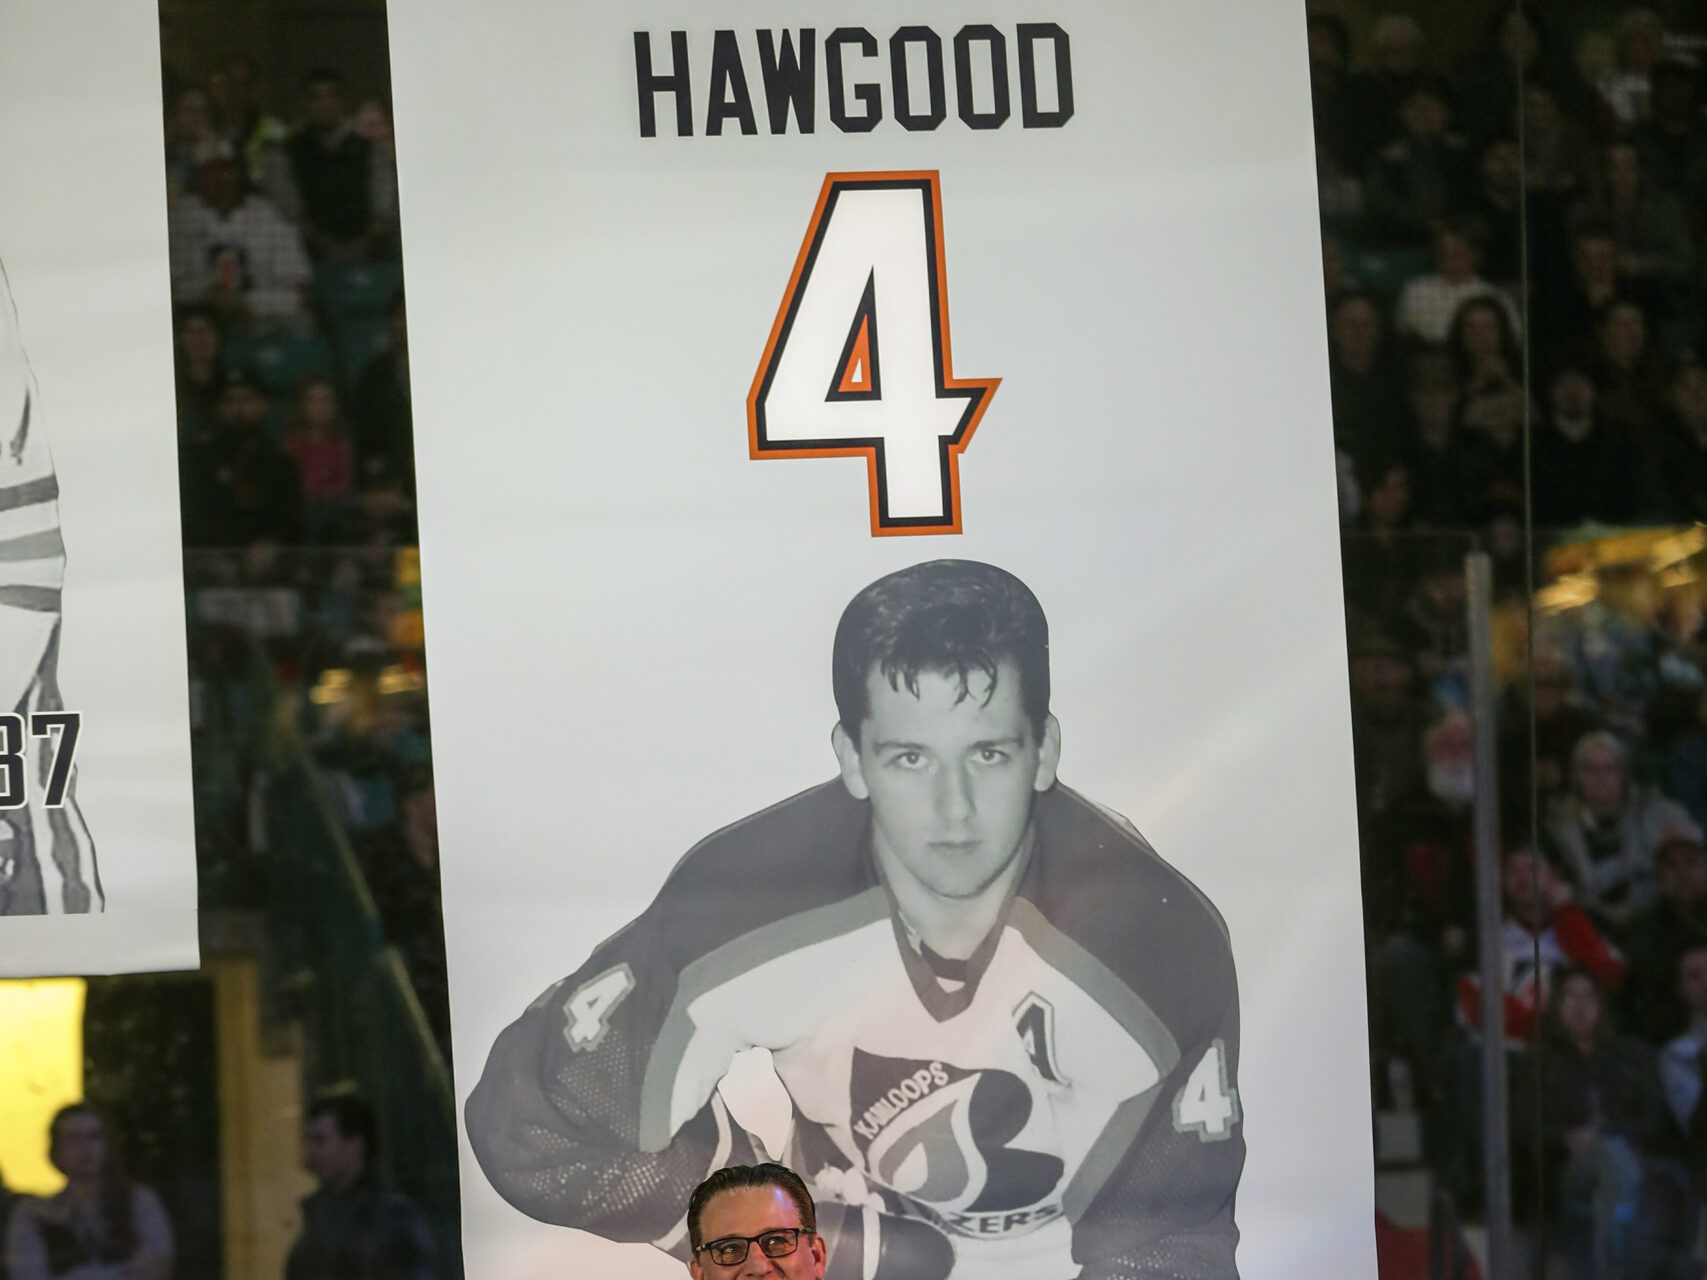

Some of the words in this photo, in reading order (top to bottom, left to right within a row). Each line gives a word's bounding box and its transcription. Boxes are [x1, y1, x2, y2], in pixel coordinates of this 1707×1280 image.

[633, 22, 1075, 138] HAWGOOD
[746, 169, 1003, 538] 4
[562, 962, 636, 1053] 4
[853, 1061, 949, 1140] KAMLOOPS
[1172, 1038, 1239, 1142] 4
